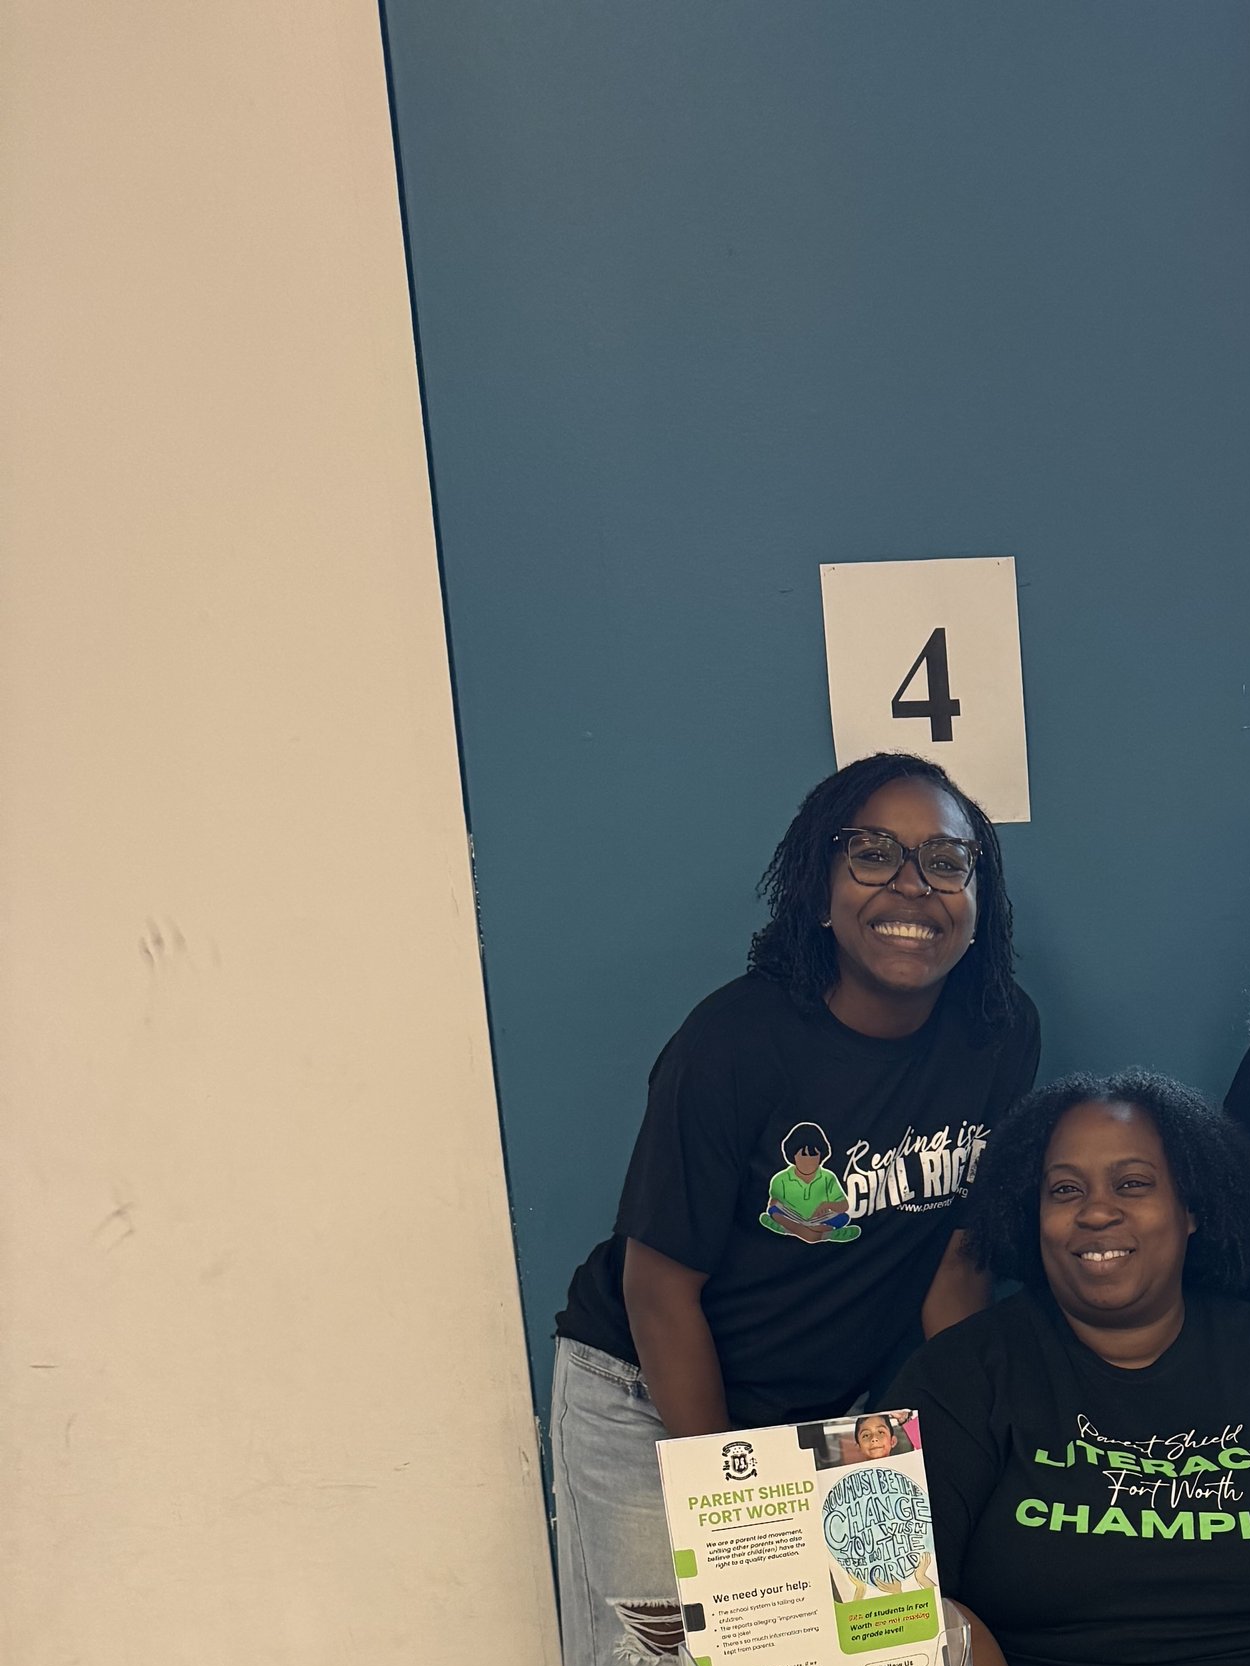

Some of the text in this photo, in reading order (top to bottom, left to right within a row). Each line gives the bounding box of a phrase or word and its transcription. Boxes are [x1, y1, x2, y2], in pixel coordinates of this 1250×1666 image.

[891, 627, 960, 742] 4
[1077, 1414, 1244, 1460] Parent Shield
[688, 1480, 814, 1510] PARENT SHIELD
[823, 1482, 843, 1513] YOU
[843, 1469, 877, 1504] MUST
[876, 1469, 898, 1494] BE
[1103, 1469, 1244, 1510] Fort Worth
[699, 1498, 810, 1527] FORT WORTH
[824, 1496, 932, 1551] CHANGE
[840, 1520, 927, 1558] YOU WISH
[876, 1534, 925, 1561] THE
[846, 1552, 921, 1587] WORLD
[712, 1581, 811, 1603] We need your help:
[874, 1607, 905, 1617] students
[915, 1602, 929, 1610] Fort
[850, 1622, 873, 1631] Worth
[862, 1631, 883, 1641] grade
